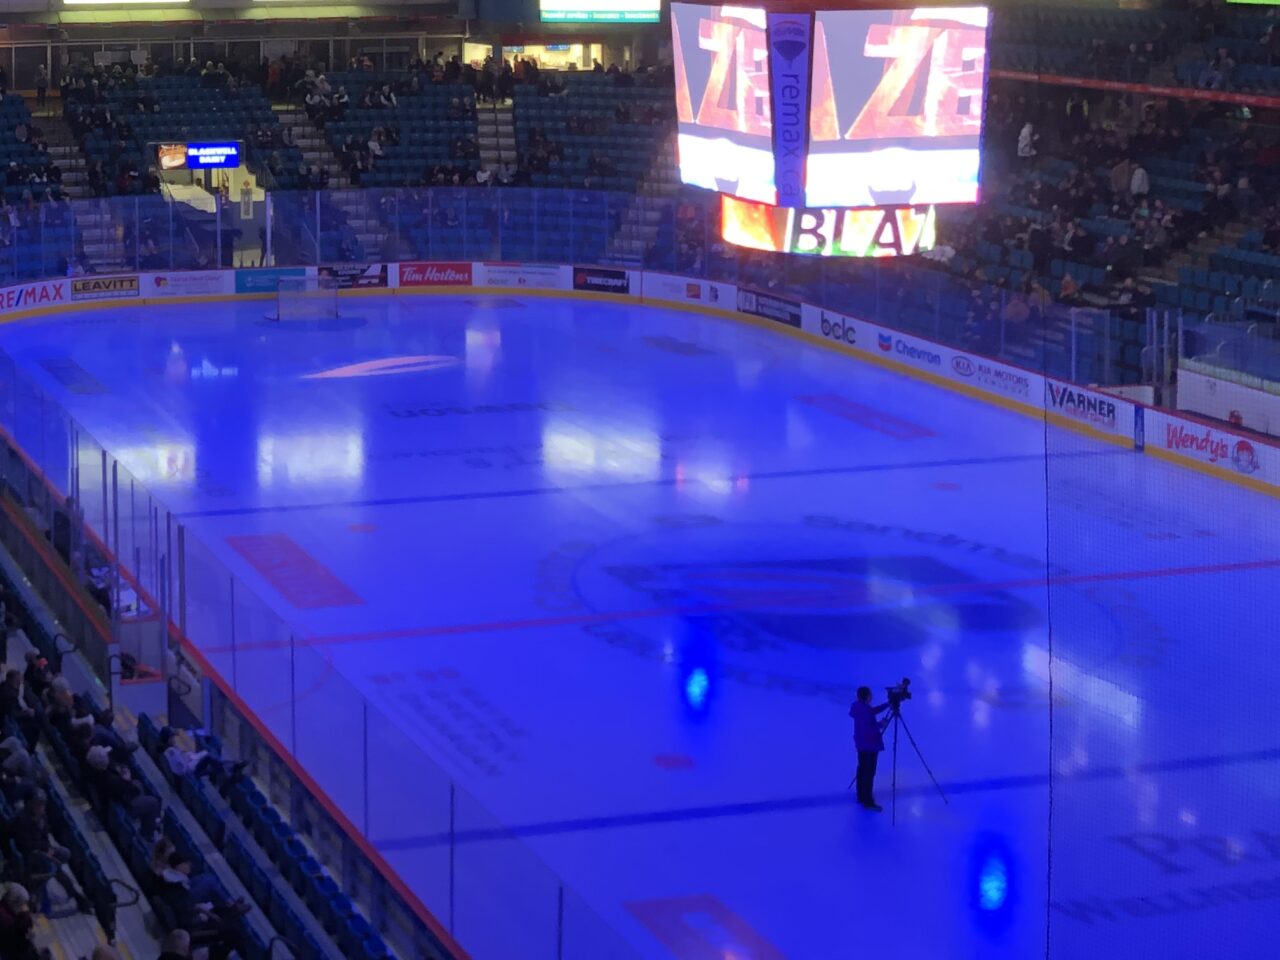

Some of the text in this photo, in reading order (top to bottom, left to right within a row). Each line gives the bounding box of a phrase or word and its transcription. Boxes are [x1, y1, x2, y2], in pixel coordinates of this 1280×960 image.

[780, 73, 802, 198] remax.ca
[74, 278, 136, 292] LEAVITT
[402, 267, 469, 282] Tim Hortons
[821, 311, 856, 345] bclc
[896, 339, 942, 366] Chevron
[994, 368, 1030, 388] MOTORS
[1048, 382, 1116, 420] WARNER
[1167, 423, 1229, 464] Wendy's
